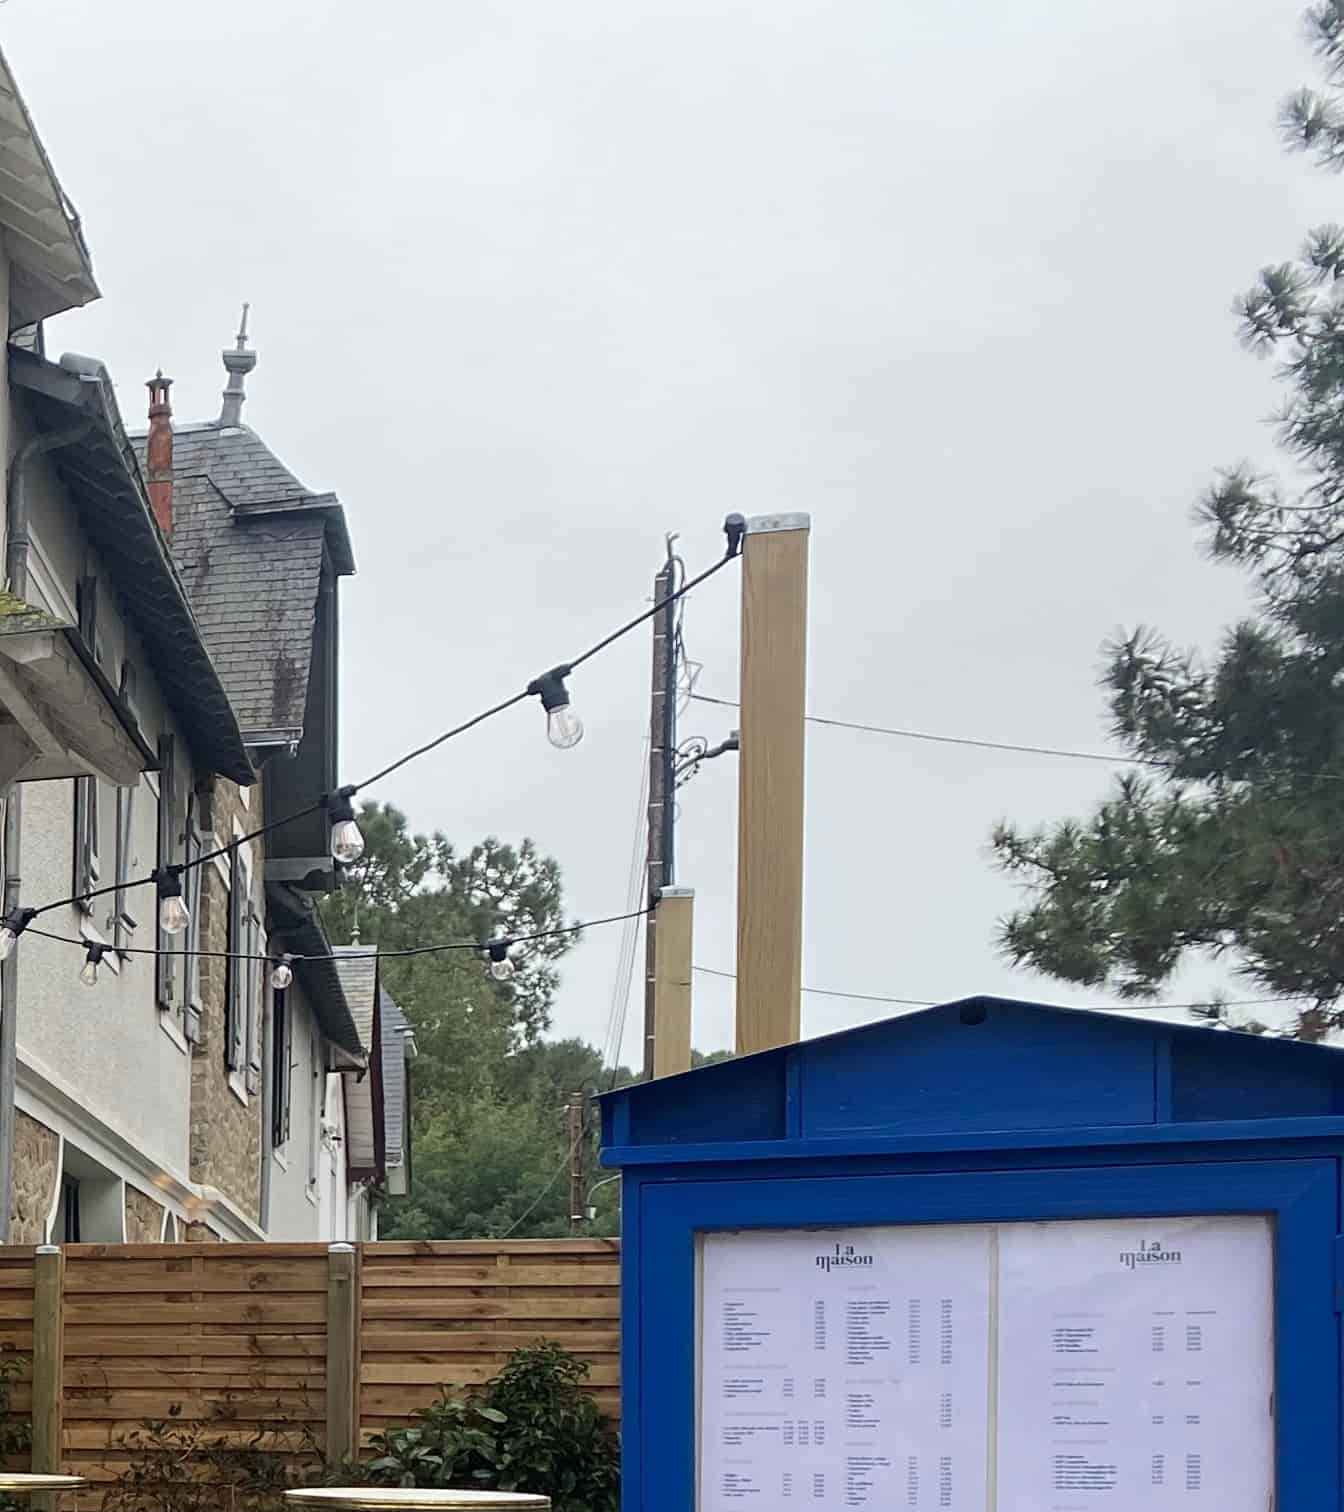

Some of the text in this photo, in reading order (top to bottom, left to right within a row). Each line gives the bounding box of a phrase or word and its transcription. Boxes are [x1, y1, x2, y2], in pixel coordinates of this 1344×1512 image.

[835, 1243, 854, 1255] La
[1140, 1239, 1161, 1252] La
[816, 1254, 873, 1272] maison
[1120, 1250, 1181, 1269] maison
